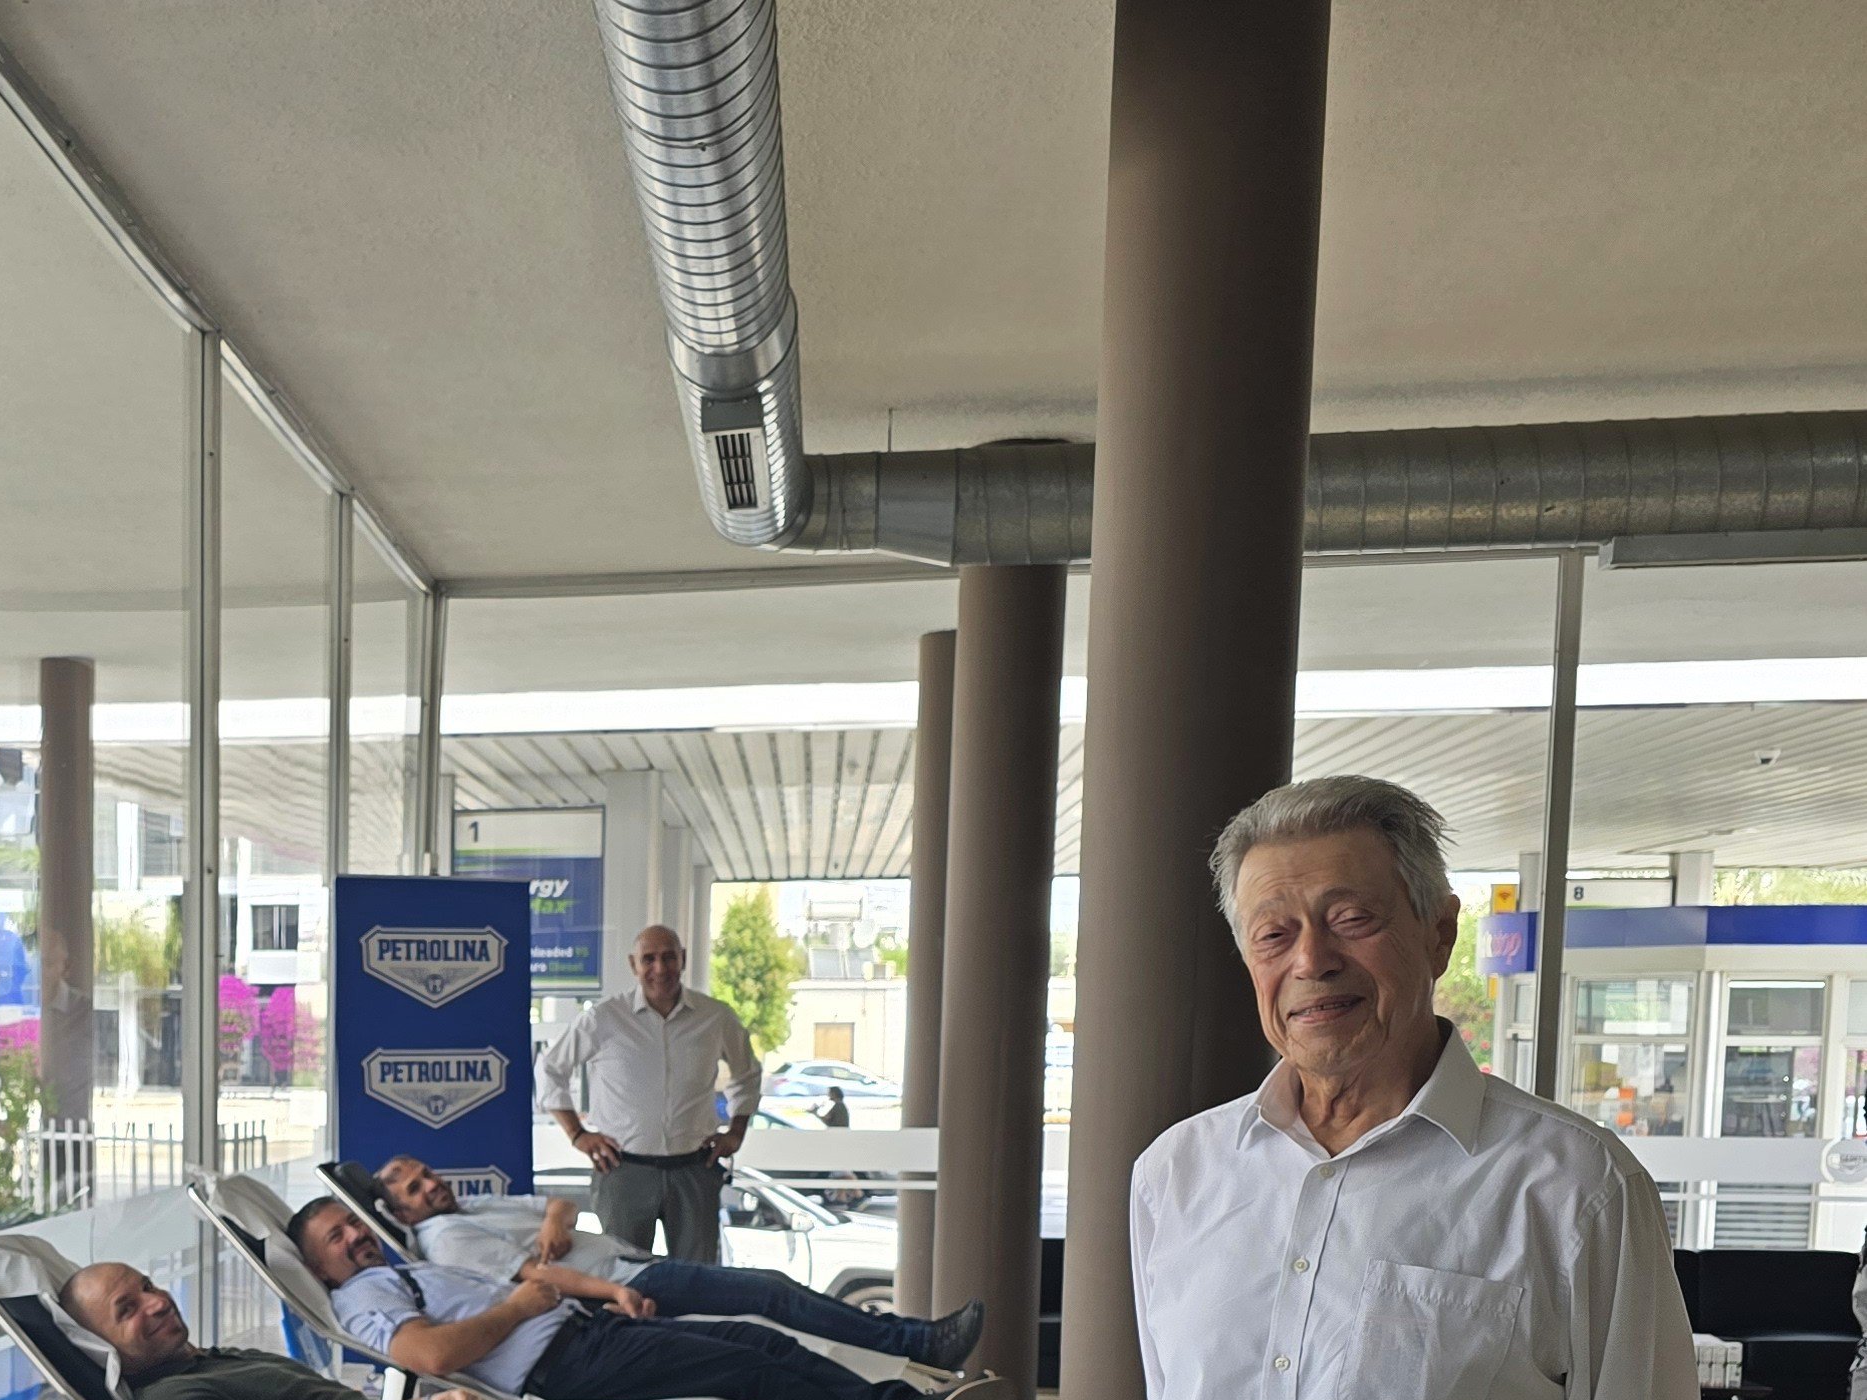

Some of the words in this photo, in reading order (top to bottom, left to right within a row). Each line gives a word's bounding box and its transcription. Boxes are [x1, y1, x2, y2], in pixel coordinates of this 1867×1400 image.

[469, 821, 479, 843] 1
[377, 938, 490, 962] PETROLINA
[379, 1060, 492, 1084] PETROLINA
